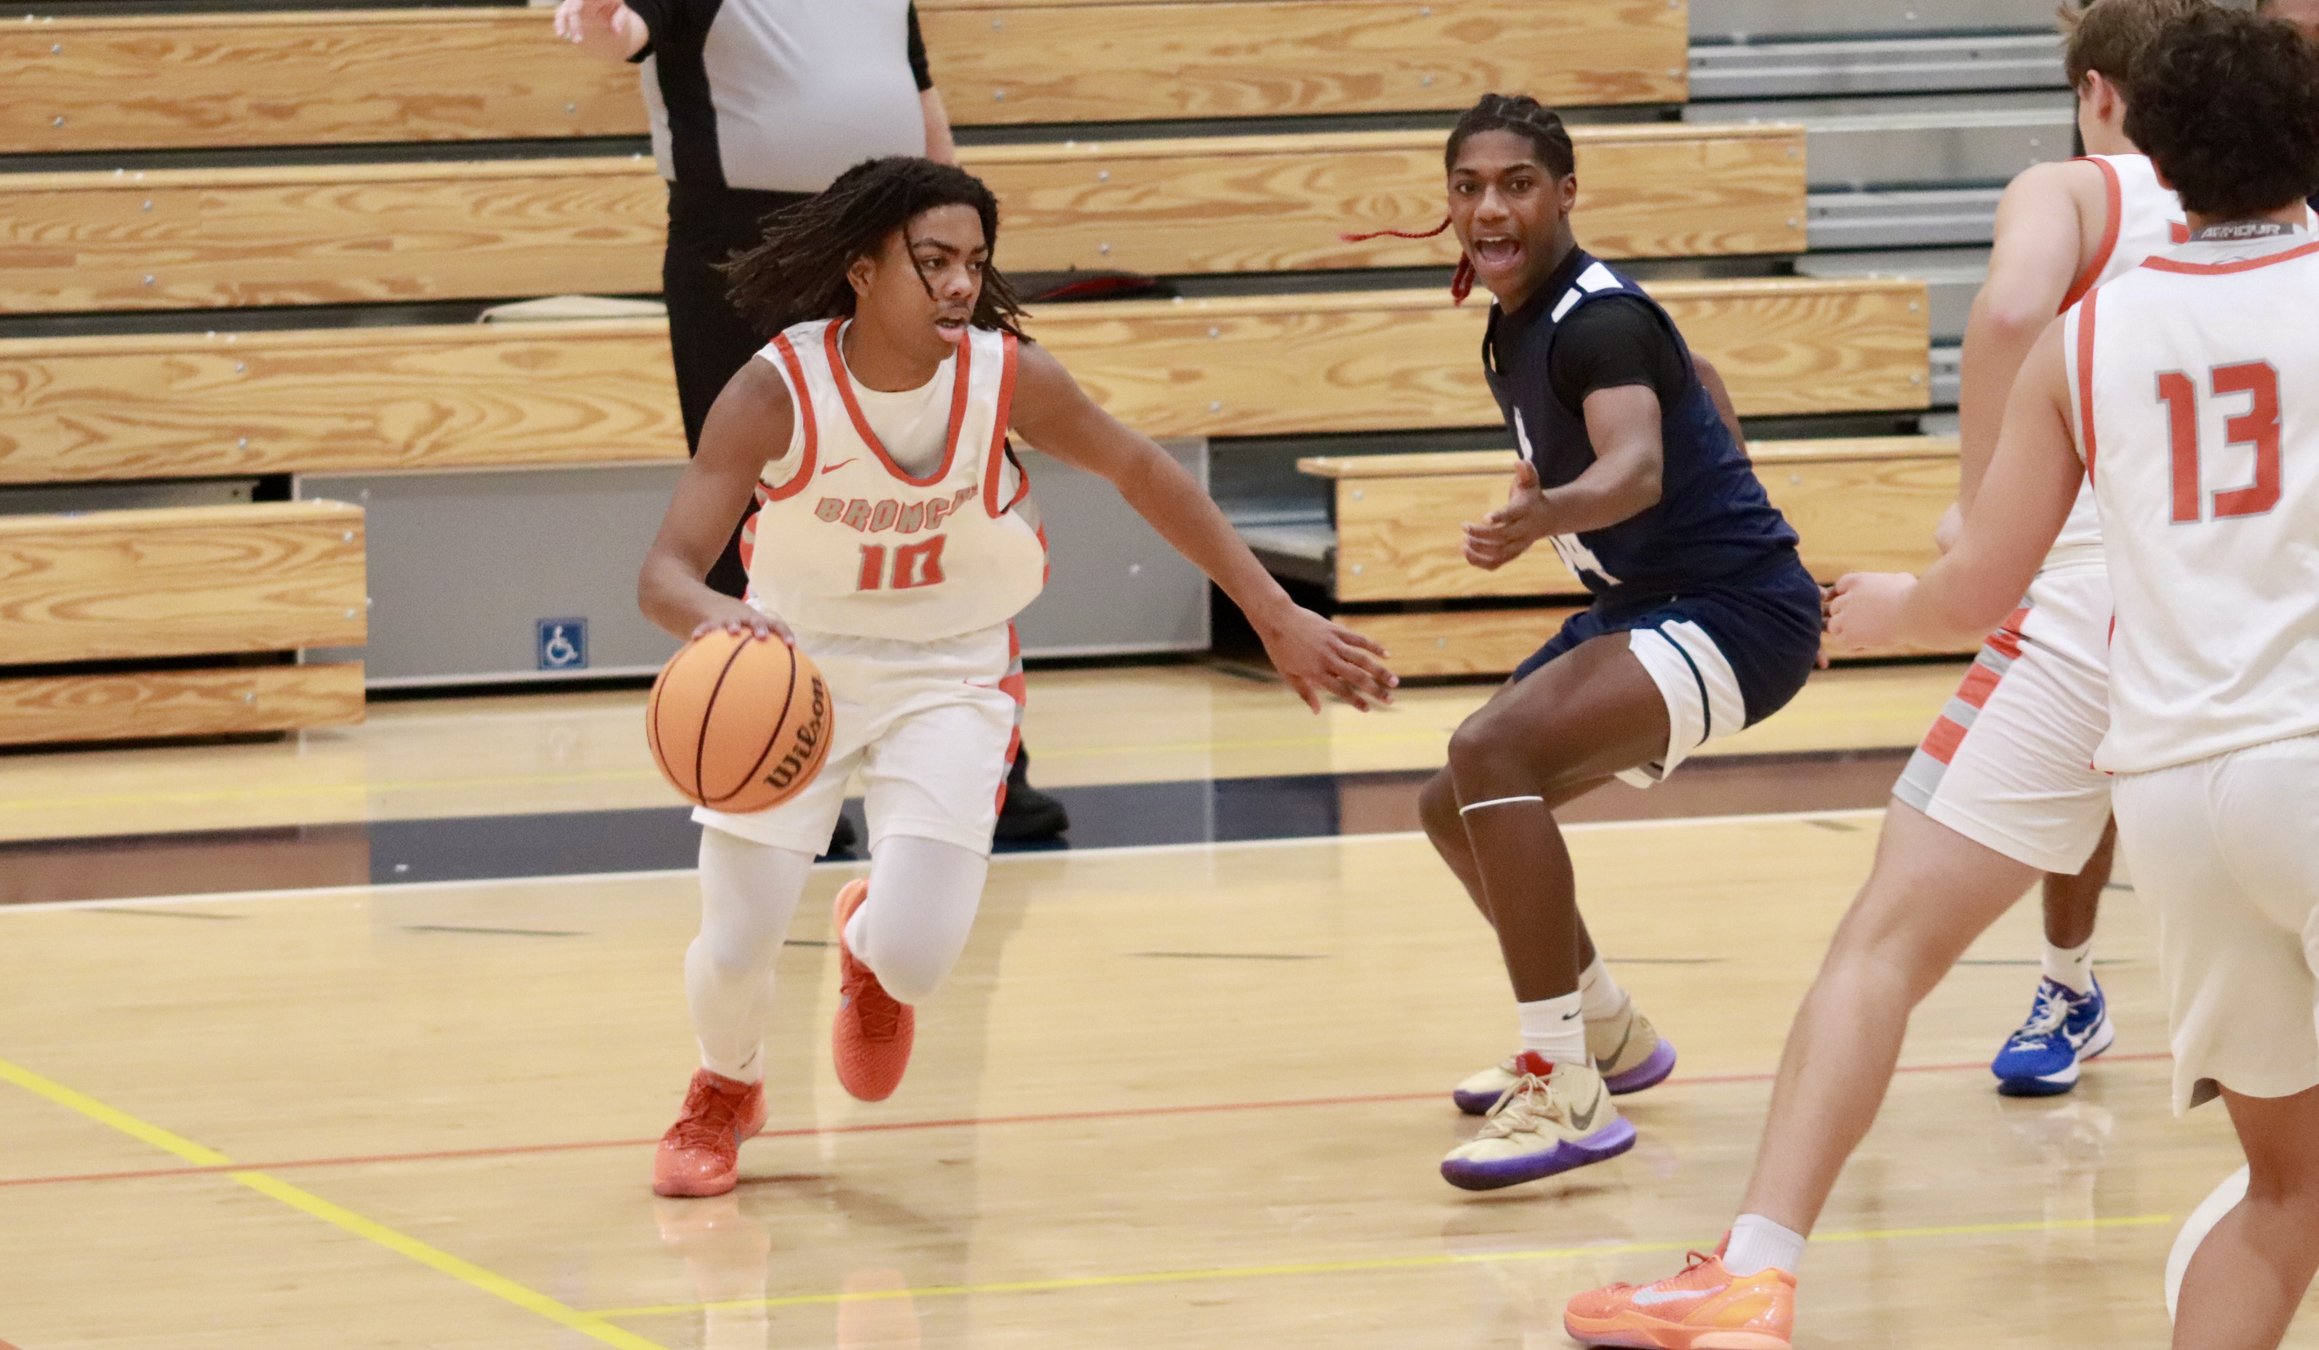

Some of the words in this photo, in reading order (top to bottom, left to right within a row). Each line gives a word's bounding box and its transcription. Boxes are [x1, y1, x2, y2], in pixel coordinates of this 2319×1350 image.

[2154, 357, 2284, 526] 13
[814, 484, 979, 535] BRONC
[856, 533, 948, 592] 10
[763, 673, 825, 790] Wilson
